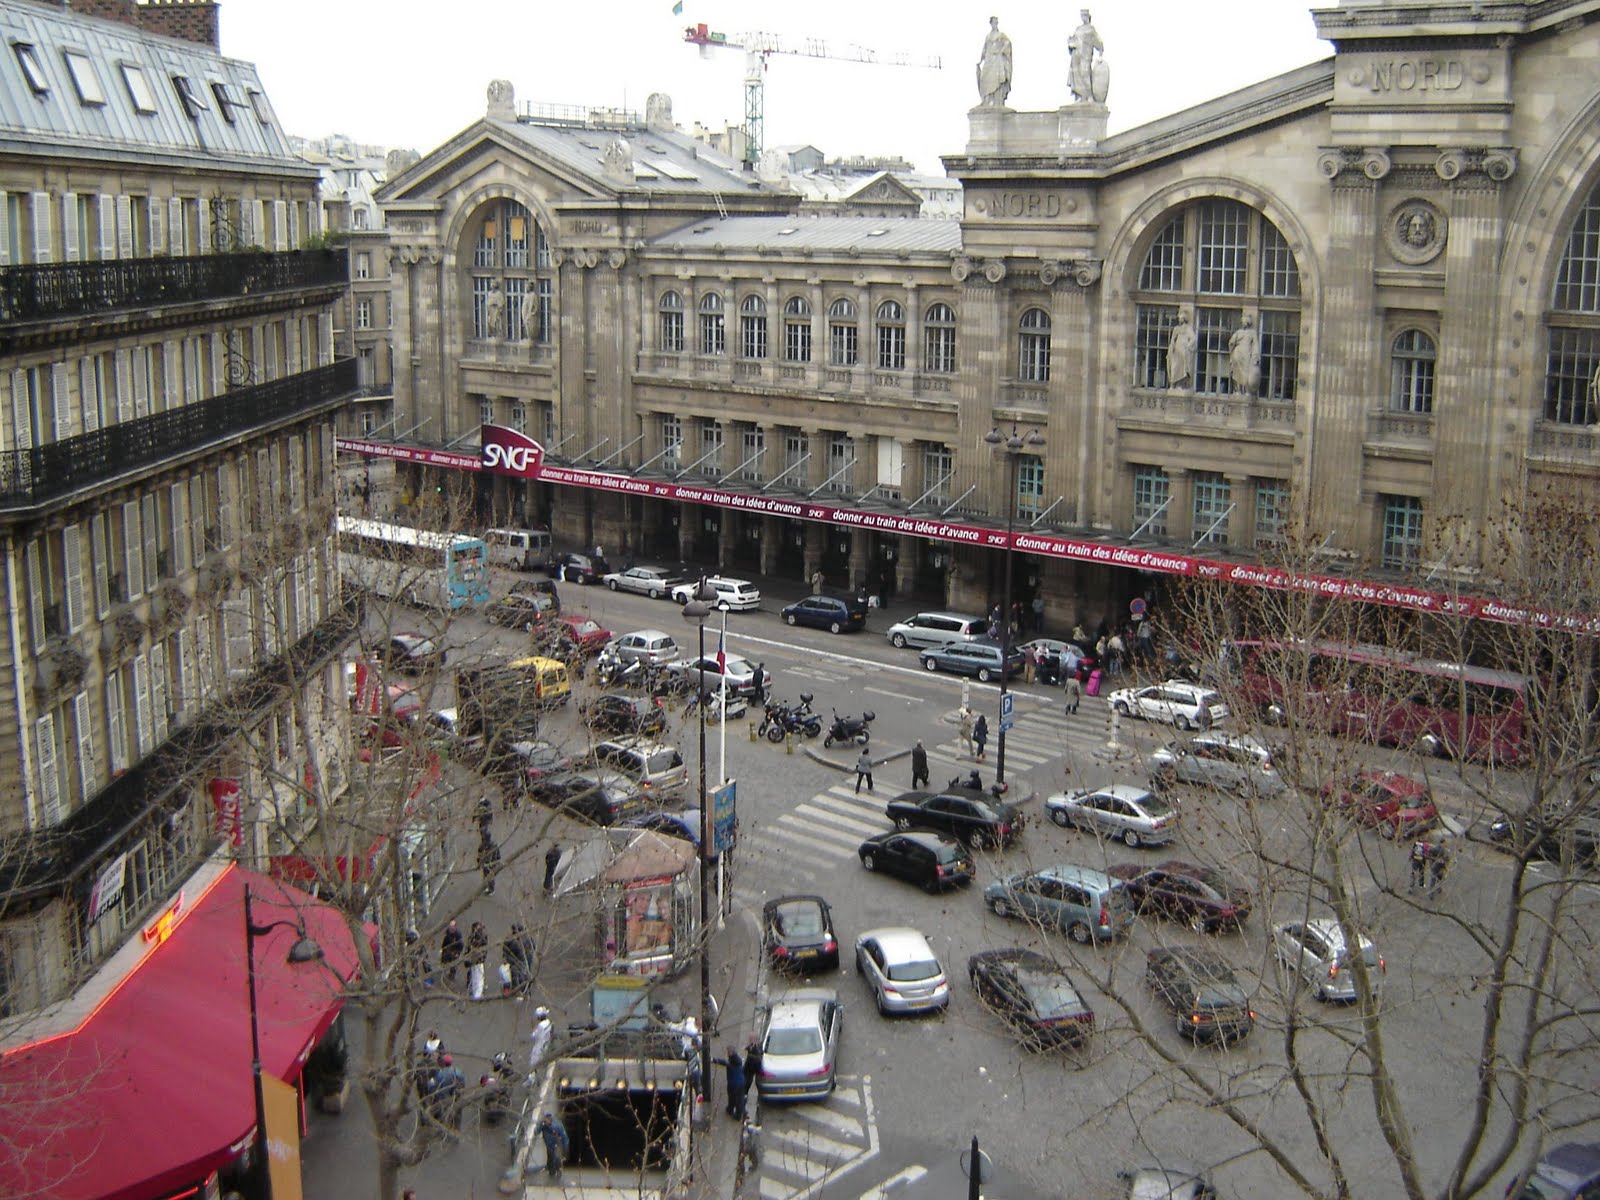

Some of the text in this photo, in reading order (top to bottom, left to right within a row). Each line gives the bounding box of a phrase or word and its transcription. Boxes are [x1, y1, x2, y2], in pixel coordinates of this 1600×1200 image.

[1370, 61, 1464, 92] NORD
[986, 193, 1061, 218] NORD
[483, 443, 539, 471] SNCF
[541, 468, 564, 479] donner
[564, 473, 573, 481] au
[573, 473, 589, 484] train
[590, 475, 601, 485] des
[601, 477, 619, 488] idées
[620, 479, 650, 492] d'avance
[675, 487, 702, 500] donner
[702, 492, 712, 501] au
[713, 493, 731, 504] train
[731, 495, 745, 506] des
[746, 497, 766, 509] idées
[767, 500, 801, 515] d'avance
[808, 509, 824, 518] SNCF
[832, 509, 863, 523] donner
[863, 516, 875, 525] au
[876, 517, 896, 529] train
[898, 519, 913, 532] des
[914, 521, 938, 535] idées
[939, 524, 979, 541] d'avance
[987, 535, 1007, 545] SNCF
[1016, 536, 1051, 550] donner
[1052, 543, 1065, 553] au
[1067, 544, 1091, 557] train
[1092, 546, 1110, 559] des
[1111, 549, 1139, 564] idées
[1140, 553, 1188, 570] d'avance
[1320, 580, 1341, 594] des
[1481, 602, 1528, 619] donne
